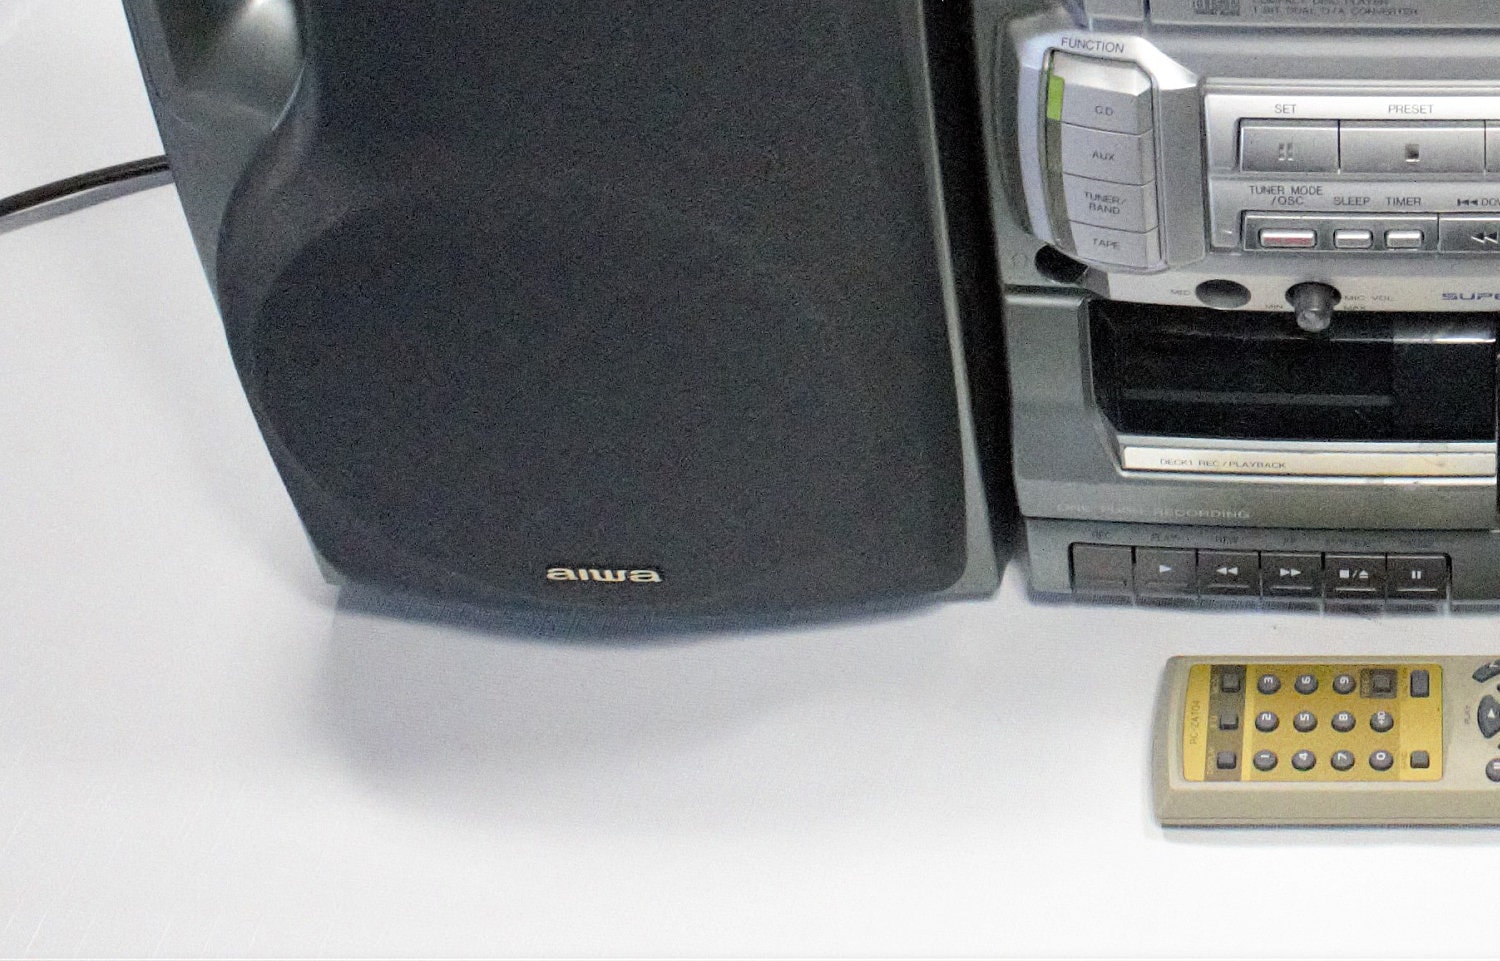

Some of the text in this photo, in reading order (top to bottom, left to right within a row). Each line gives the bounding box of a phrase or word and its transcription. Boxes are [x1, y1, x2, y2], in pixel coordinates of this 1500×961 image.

[1061, 36, 1125, 54] FUNCTION
[1094, 105, 1114, 115] CD
[1274, 104, 1297, 114] SET
[1388, 104, 1434, 114] PRESET
[1092, 151, 1115, 162] AUX
[1249, 185, 1323, 196] TUNER MODE
[1270, 196, 1304, 206] /OSC
[1333, 196, 1371, 206] SLEEP
[1385, 196, 1422, 207] TIMER
[1088, 202, 1120, 215] BAND
[546, 567, 663, 583] aiwa
[1263, 676, 1274, 684] 3
[1301, 676, 1311, 684] 6
[1339, 676, 1350, 684] 9
[1261, 713, 1272, 721] 2
[1300, 713, 1310, 721] 5
[1338, 713, 1349, 721] 8
[1298, 752, 1309, 761] 4
[1337, 752, 1348, 760] 7
